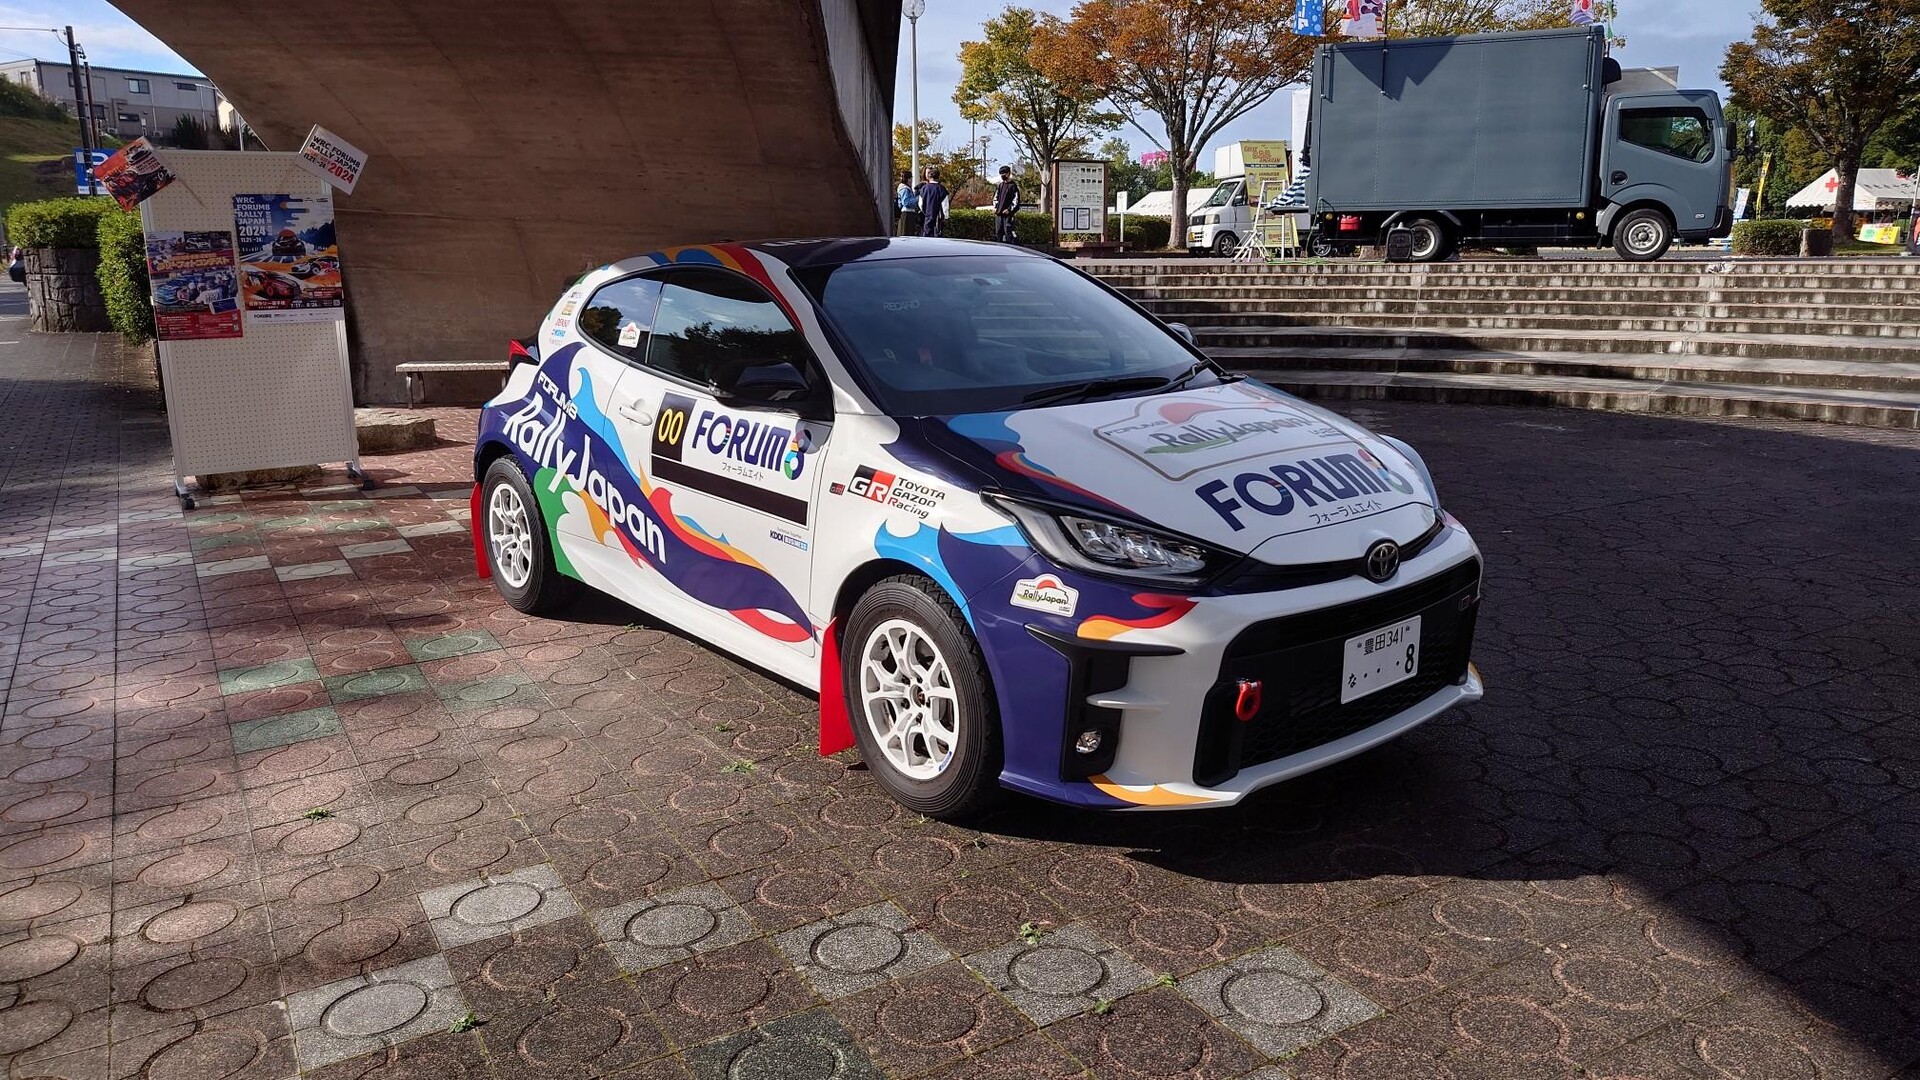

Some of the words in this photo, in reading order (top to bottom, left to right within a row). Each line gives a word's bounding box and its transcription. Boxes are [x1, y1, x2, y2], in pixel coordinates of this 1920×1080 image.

[309, 142, 334, 159] RALLY
[334, 156, 358, 174] JAPAN
[313, 136, 332, 149] WRC
[332, 146, 361, 168] FORUM8
[327, 162, 355, 184] 2024
[235, 196, 255, 204] WRC
[236, 203, 271, 211] FORUM8
[239, 225, 266, 236] 2024
[537, 370, 578, 421] FORUM8
[658, 408, 684, 446] 00
[692, 410, 808, 480] FORUM8
[721, 461, 764, 482] フォーラムエイト
[849, 476, 889, 503] GR
[892, 487, 937, 508] GAZOO
[898, 476, 946, 501] TOYOTA
[1195, 448, 1414, 532] FORUM8
[887, 497, 930, 520] Racing
[1309, 500, 1382, 525] フォーラムエイト
